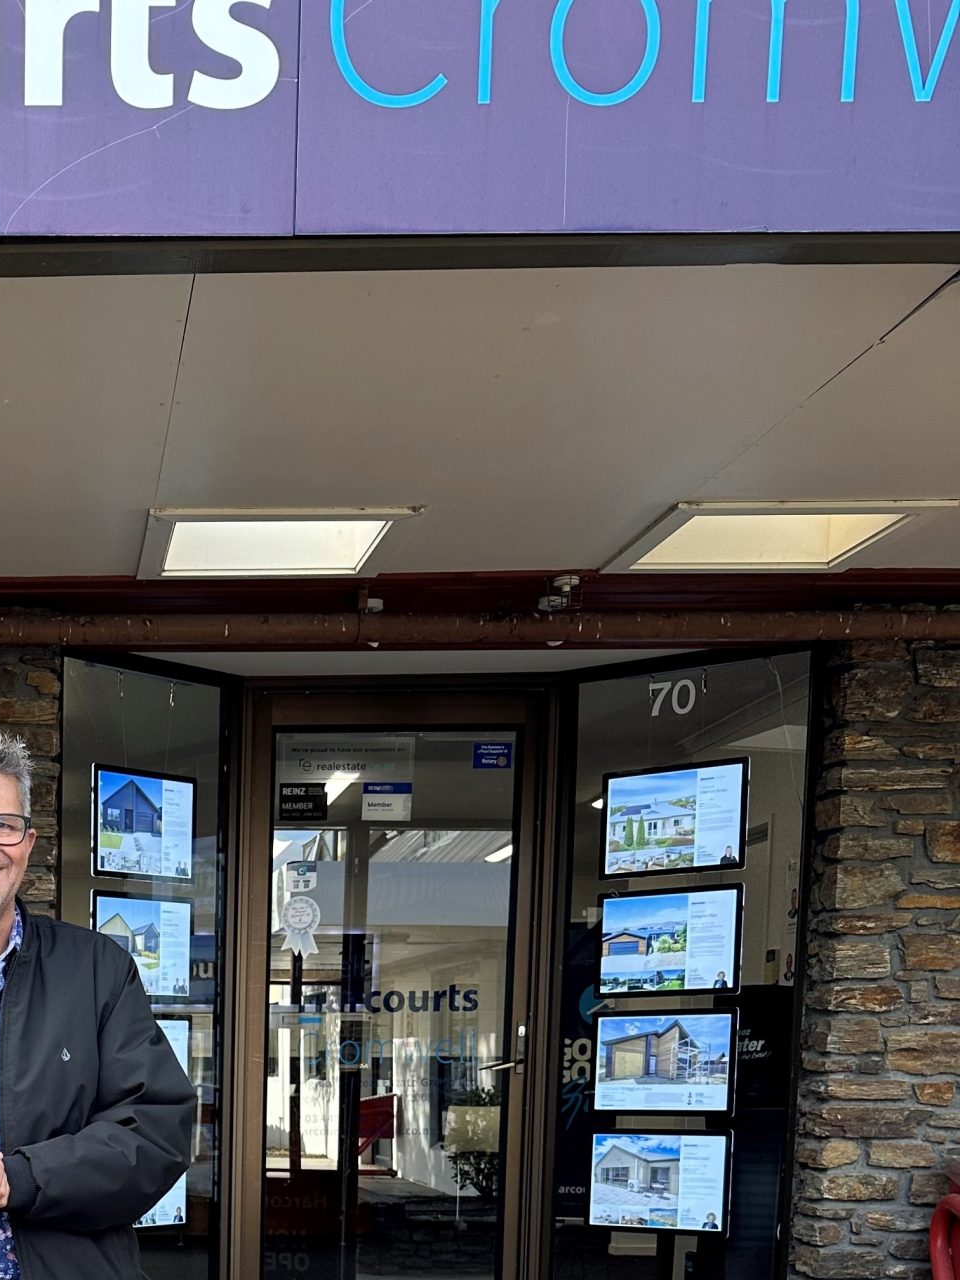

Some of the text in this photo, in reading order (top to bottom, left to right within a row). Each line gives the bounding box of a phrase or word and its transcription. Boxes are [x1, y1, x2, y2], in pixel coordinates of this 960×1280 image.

[650, 679, 696, 717] 70
[282, 787, 306, 795] REINZ
[281, 802, 313, 810] MEMBER
[298, 984, 479, 1012] courts
